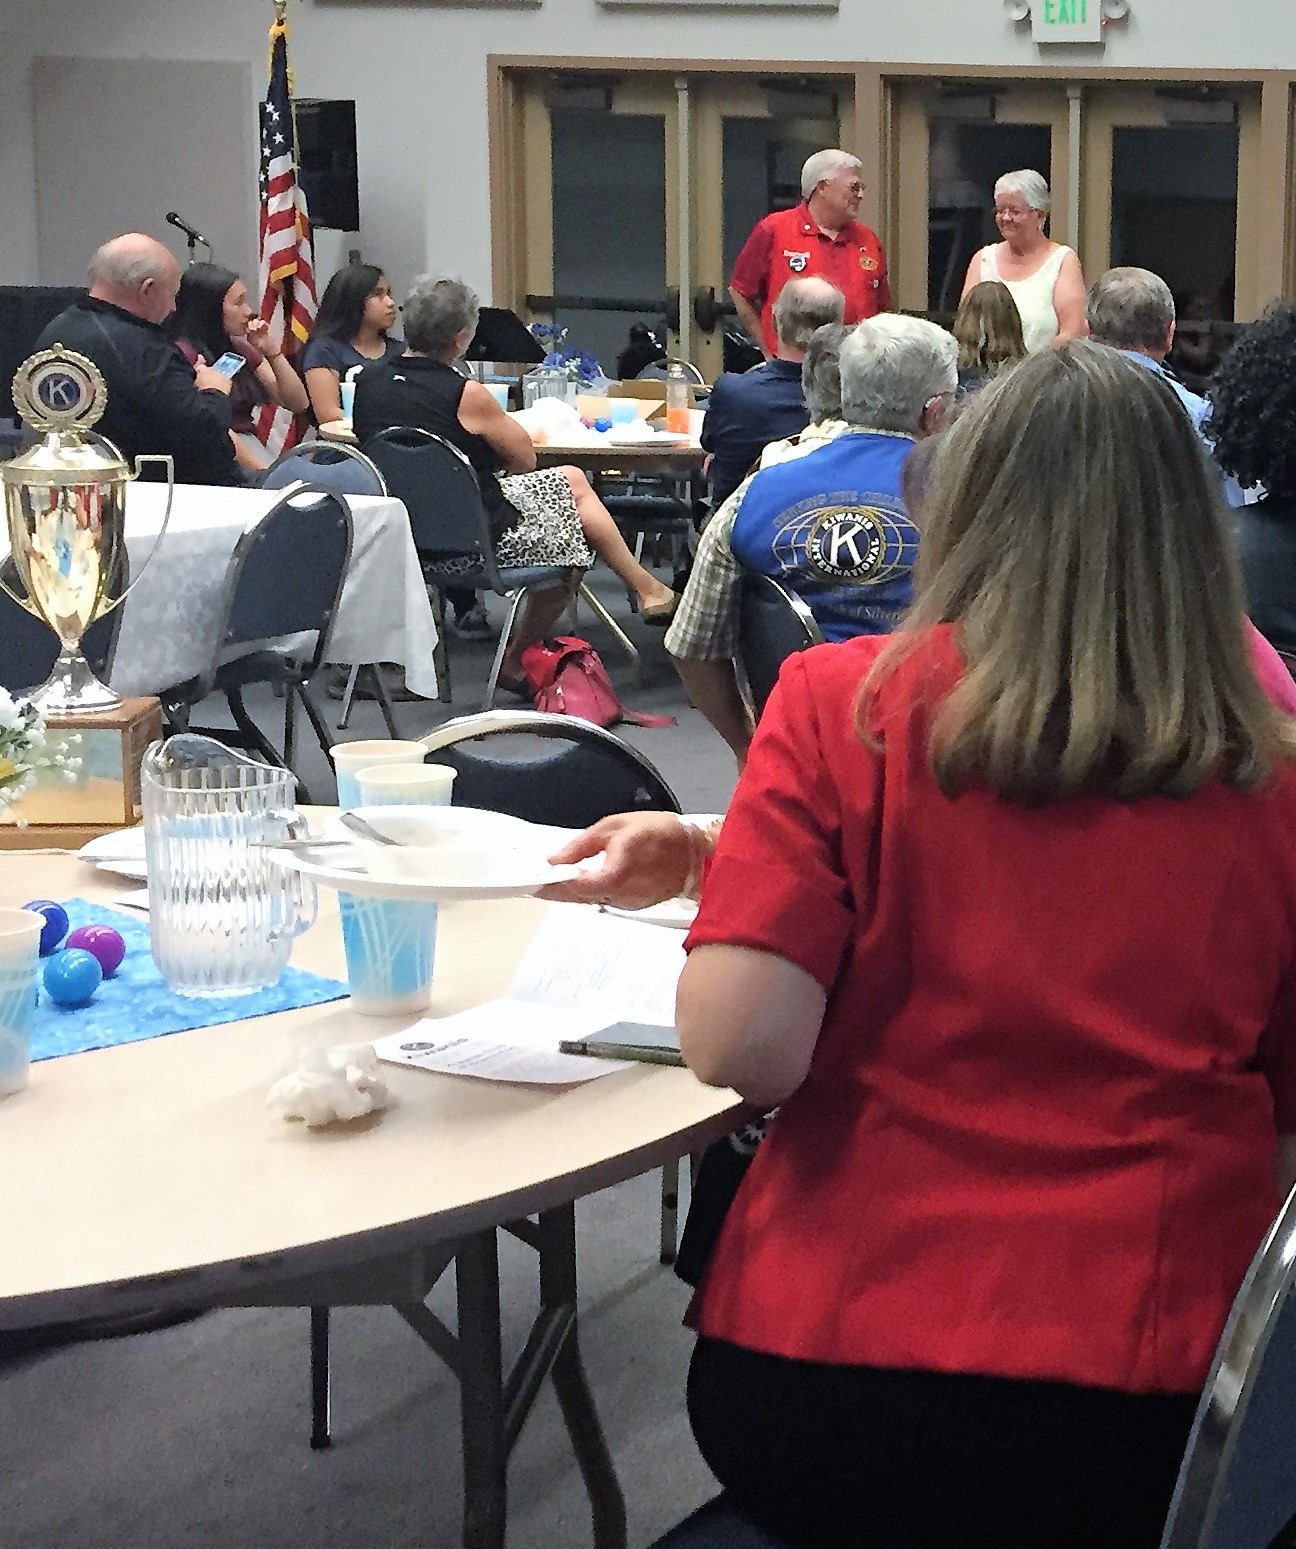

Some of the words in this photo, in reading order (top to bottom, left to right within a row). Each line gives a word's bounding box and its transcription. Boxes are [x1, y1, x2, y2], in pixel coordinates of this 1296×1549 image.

[48, 379, 71, 405] K
[821, 512, 874, 531] KIWANIS
[811, 537, 880, 577] INTERNATIONAL
[830, 522, 864, 568] K
